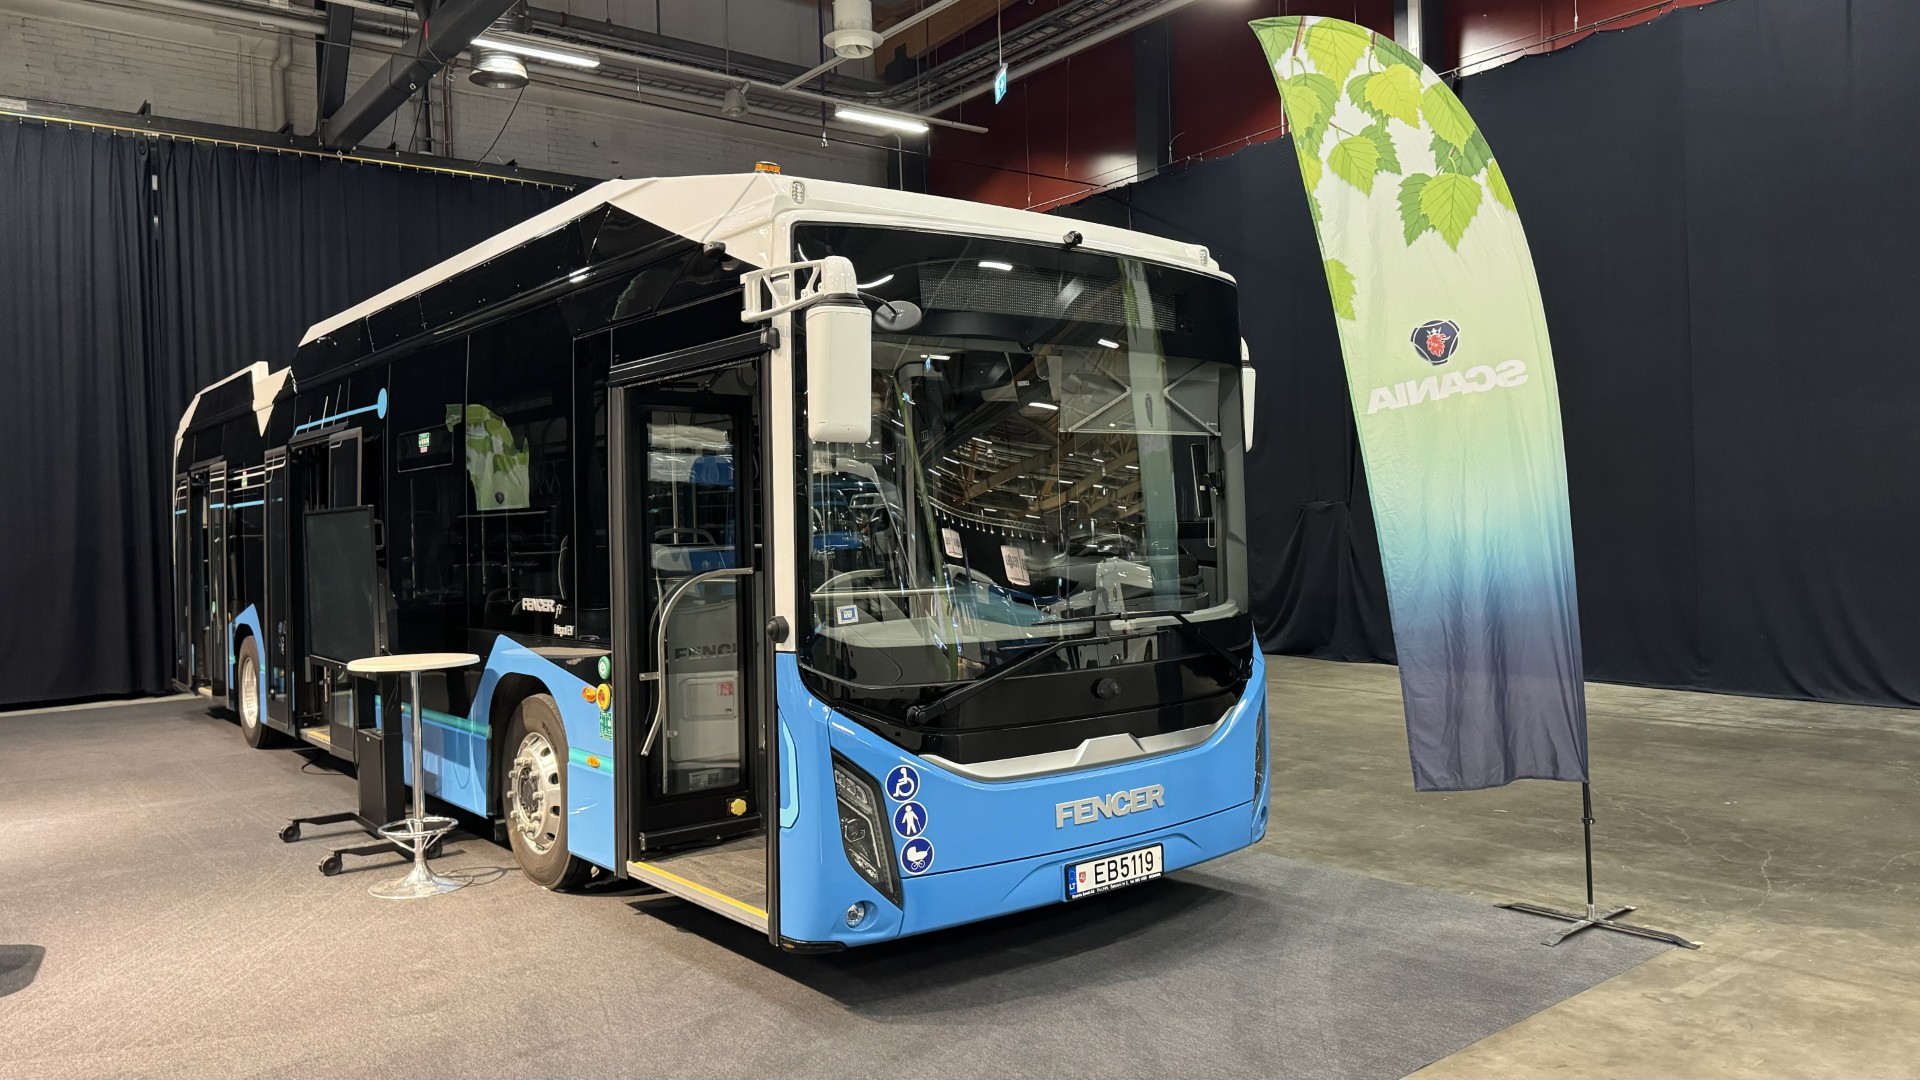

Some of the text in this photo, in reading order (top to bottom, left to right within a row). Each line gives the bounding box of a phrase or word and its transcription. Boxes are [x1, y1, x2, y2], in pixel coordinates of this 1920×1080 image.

[522, 597, 555, 612] FENCER
[1056, 783, 1165, 829] FENCER
[1069, 850, 1154, 890] LT EB5119
